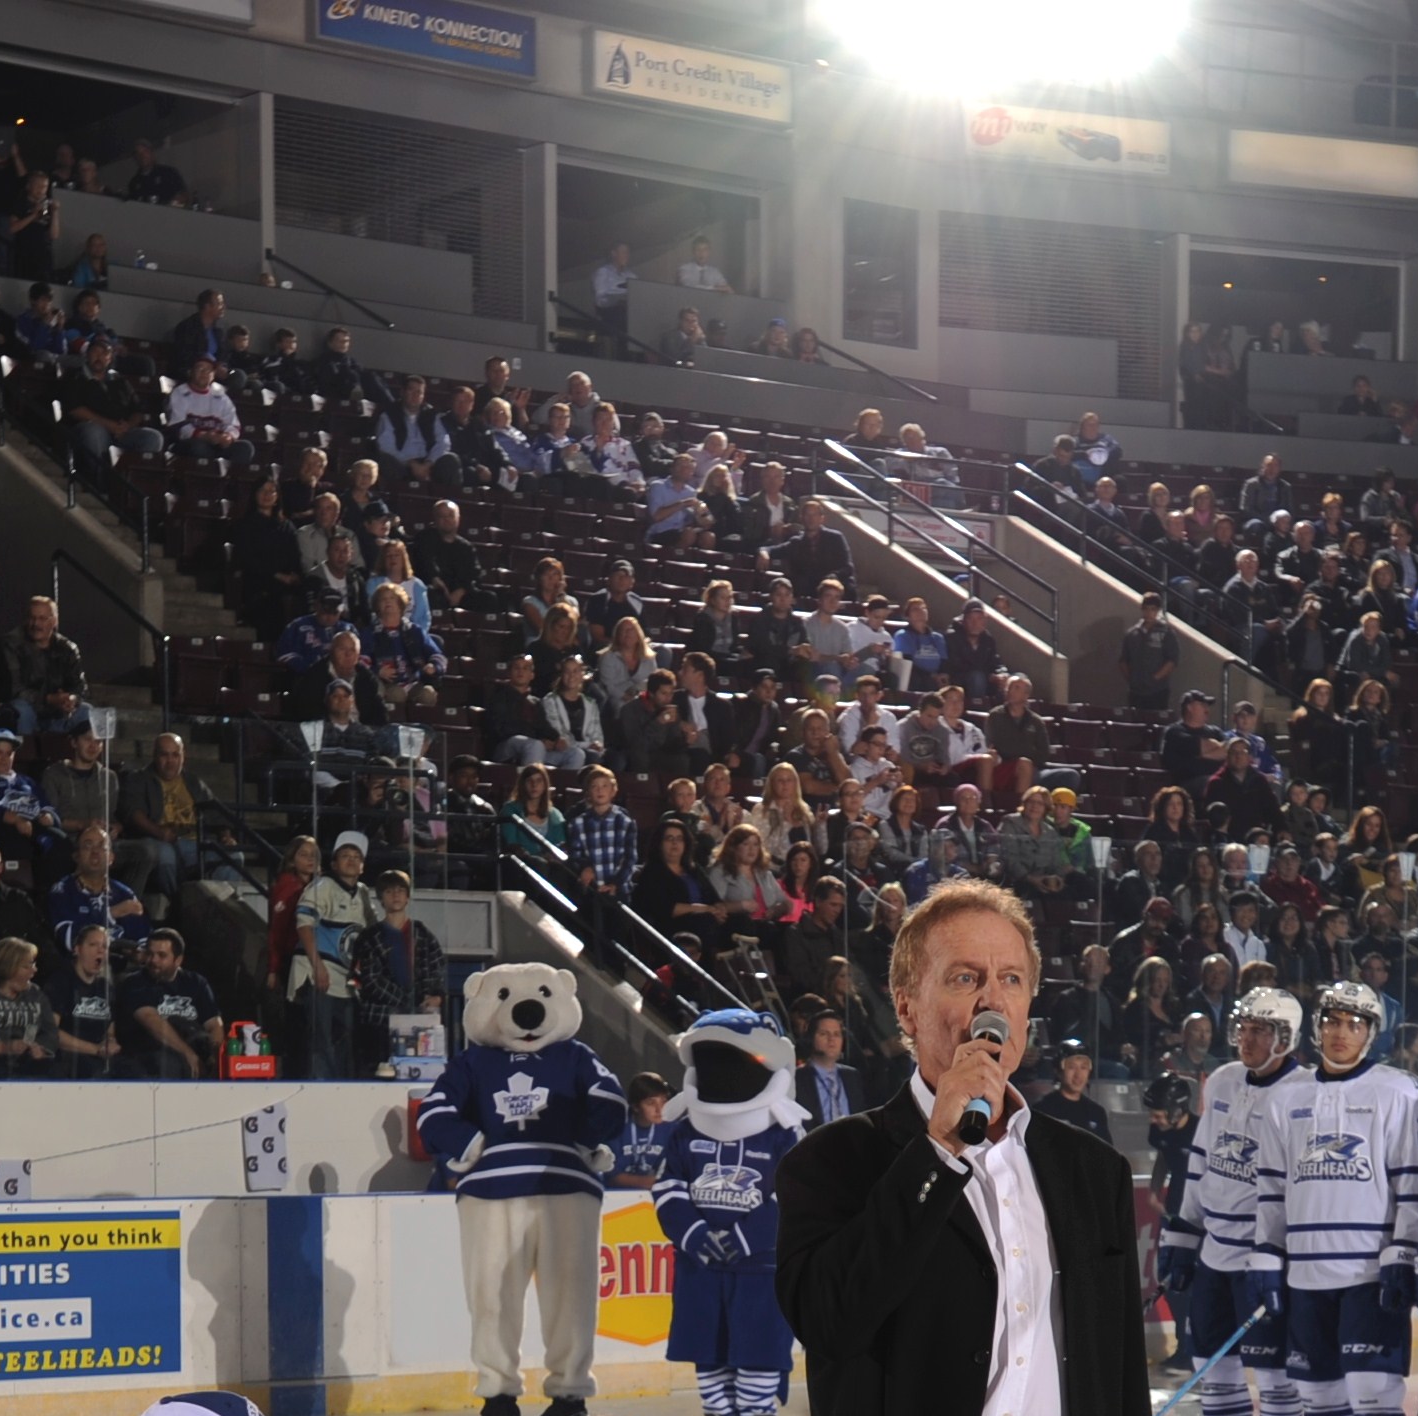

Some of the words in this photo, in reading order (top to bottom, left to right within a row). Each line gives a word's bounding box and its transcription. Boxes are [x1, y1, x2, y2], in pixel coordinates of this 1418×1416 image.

[362, 3, 421, 30] KINETIC
[423, 16, 523, 49] KONNECTION
[634, 51, 669, 74] Port
[672, 59, 723, 82] Credit
[726, 68, 783, 98] Village
[645, 77, 772, 110] RESIDENCES
[503, 1093, 541, 1103] TORONTO
[508, 1101, 535, 1110] MAPLE
[510, 1107, 532, 1117] LEAFS
[1293, 1155, 1372, 1183] STEELHEADS
[1, 1231, 51, 1248] than
[59, 1233, 98, 1251] you
[107, 1229, 162, 1246] think
[1240, 1345, 1278, 1355] CCM
[1341, 1344, 1385, 1355] CCM
